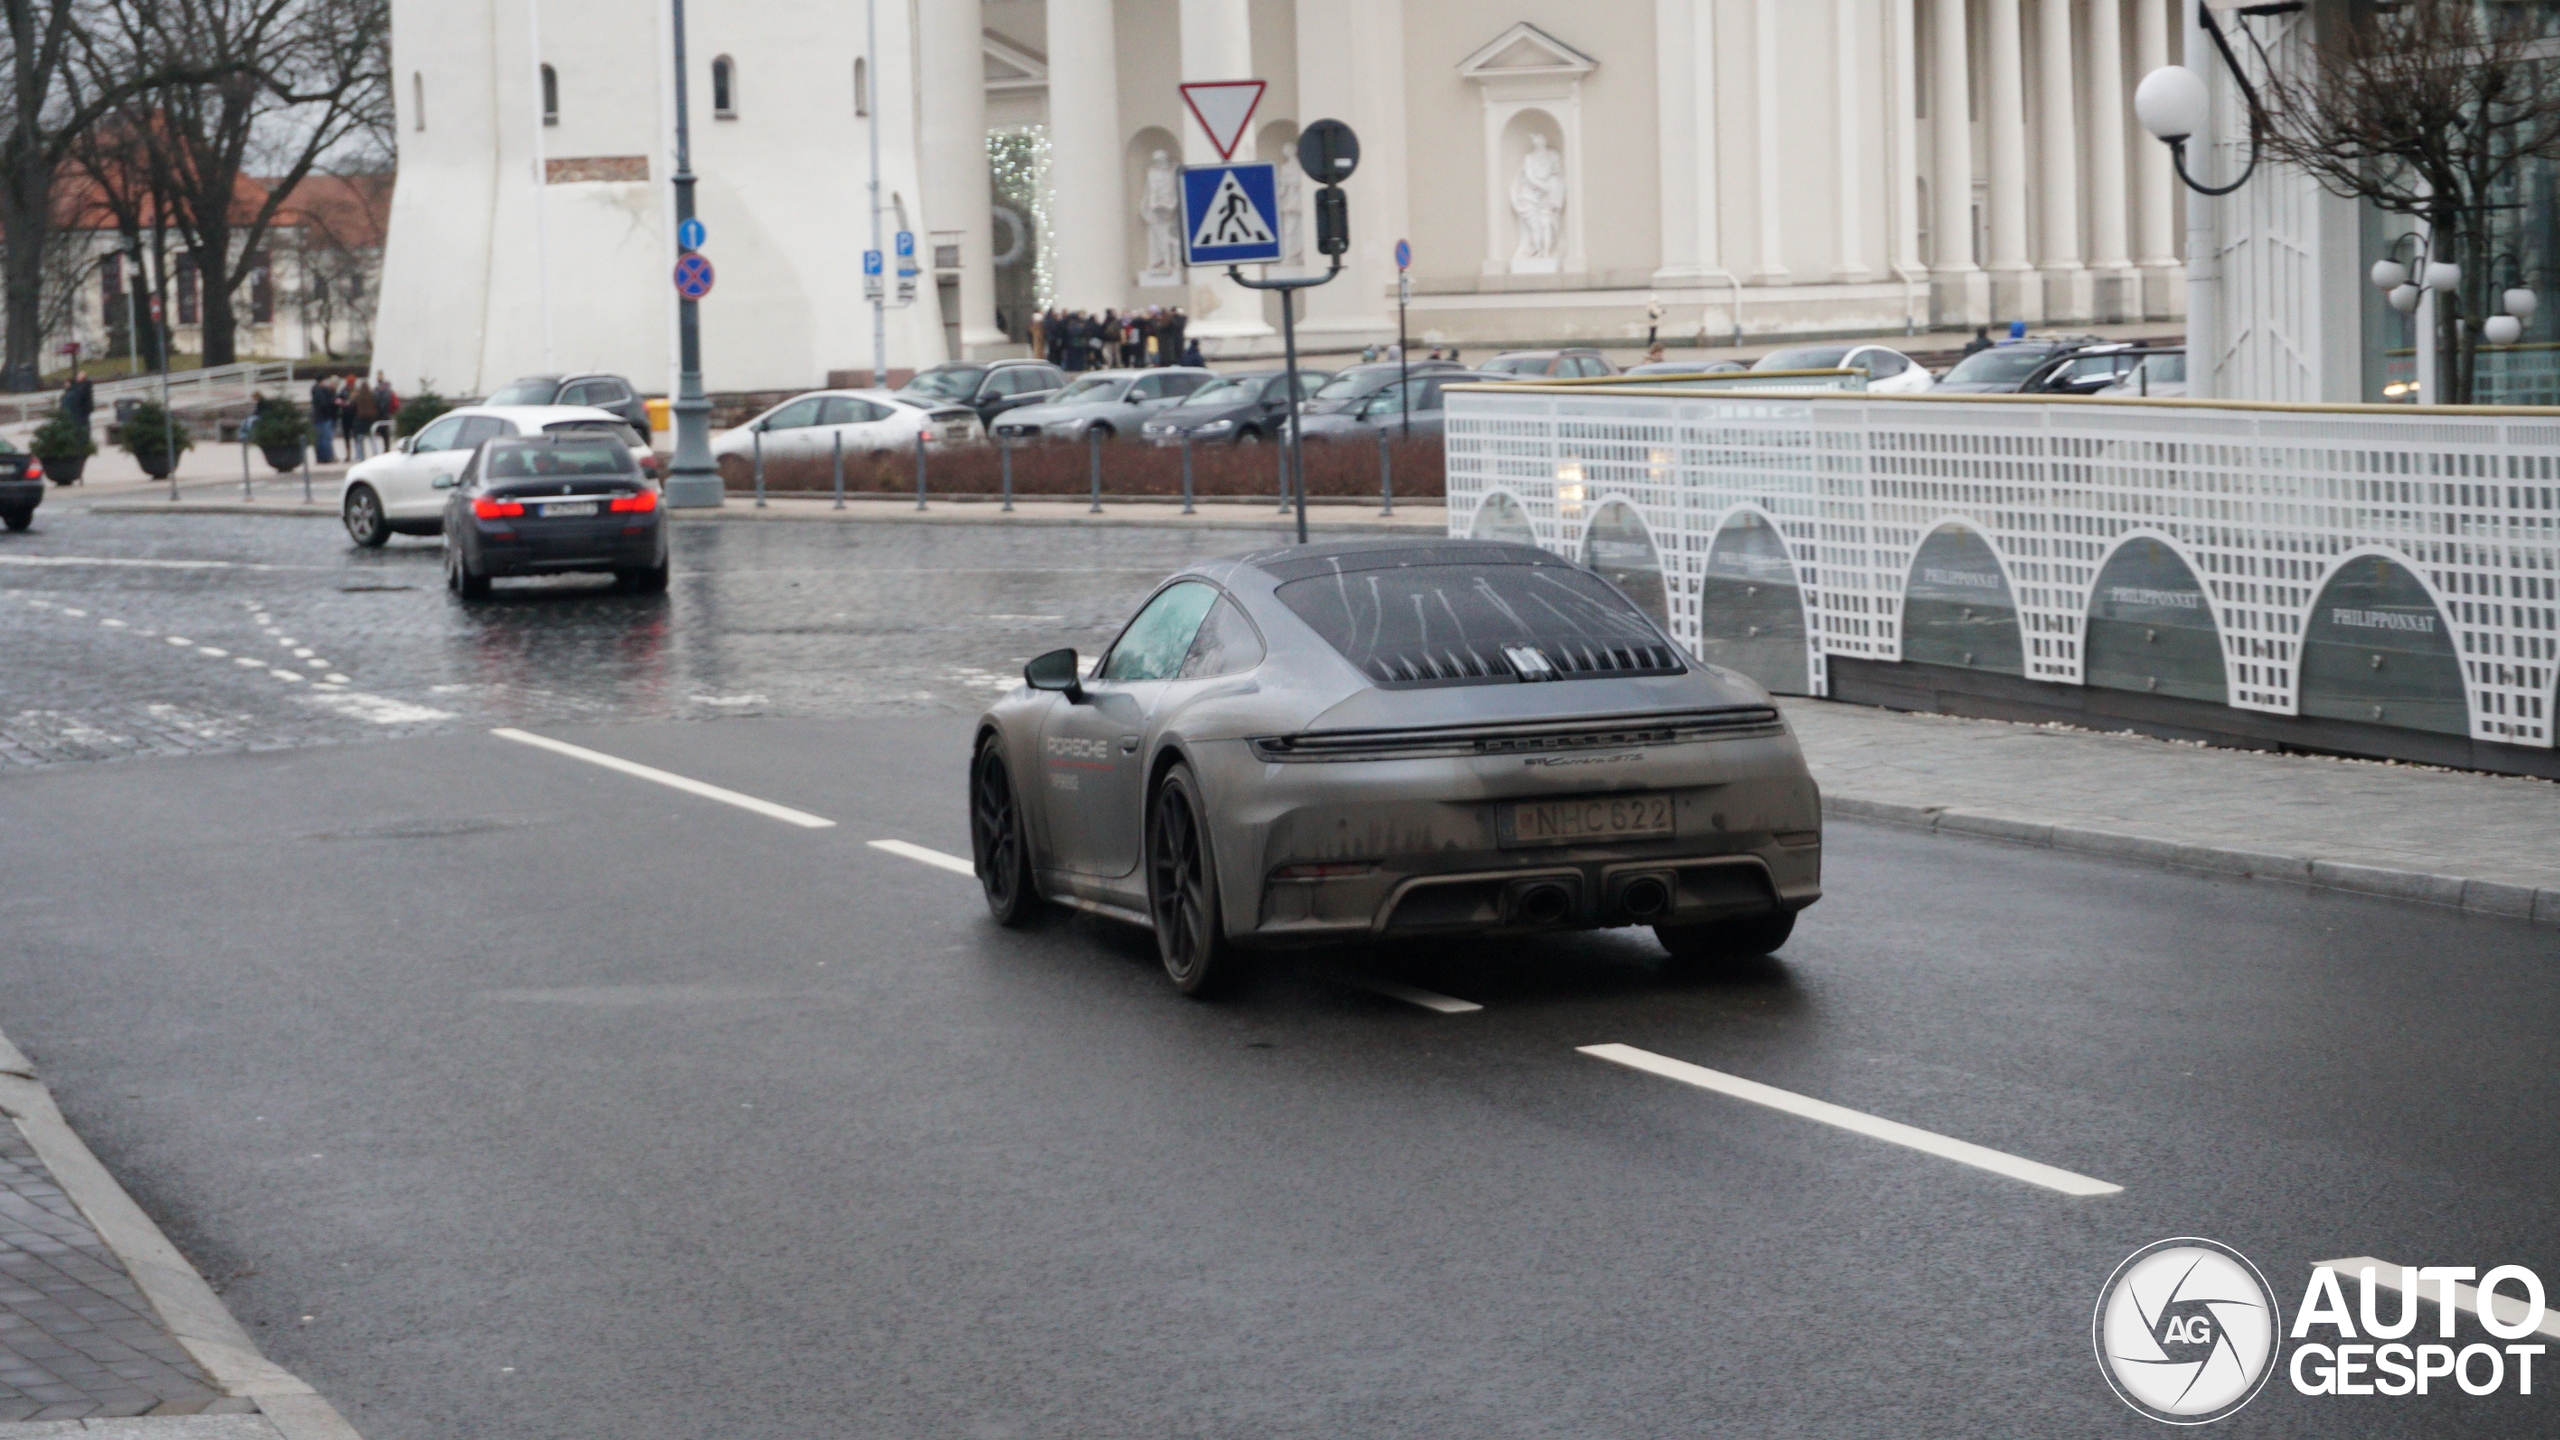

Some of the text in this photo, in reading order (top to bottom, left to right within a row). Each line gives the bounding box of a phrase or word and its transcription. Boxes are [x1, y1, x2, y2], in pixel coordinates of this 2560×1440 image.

[866, 251, 880, 272] P
[2112, 587, 2200, 608] PHILIPPONNAT
[2332, 608, 2435, 632] PHILIPPONNAT
[1047, 737, 1107, 758] PORSCHE
[1537, 800, 1667, 835] NHC 622
